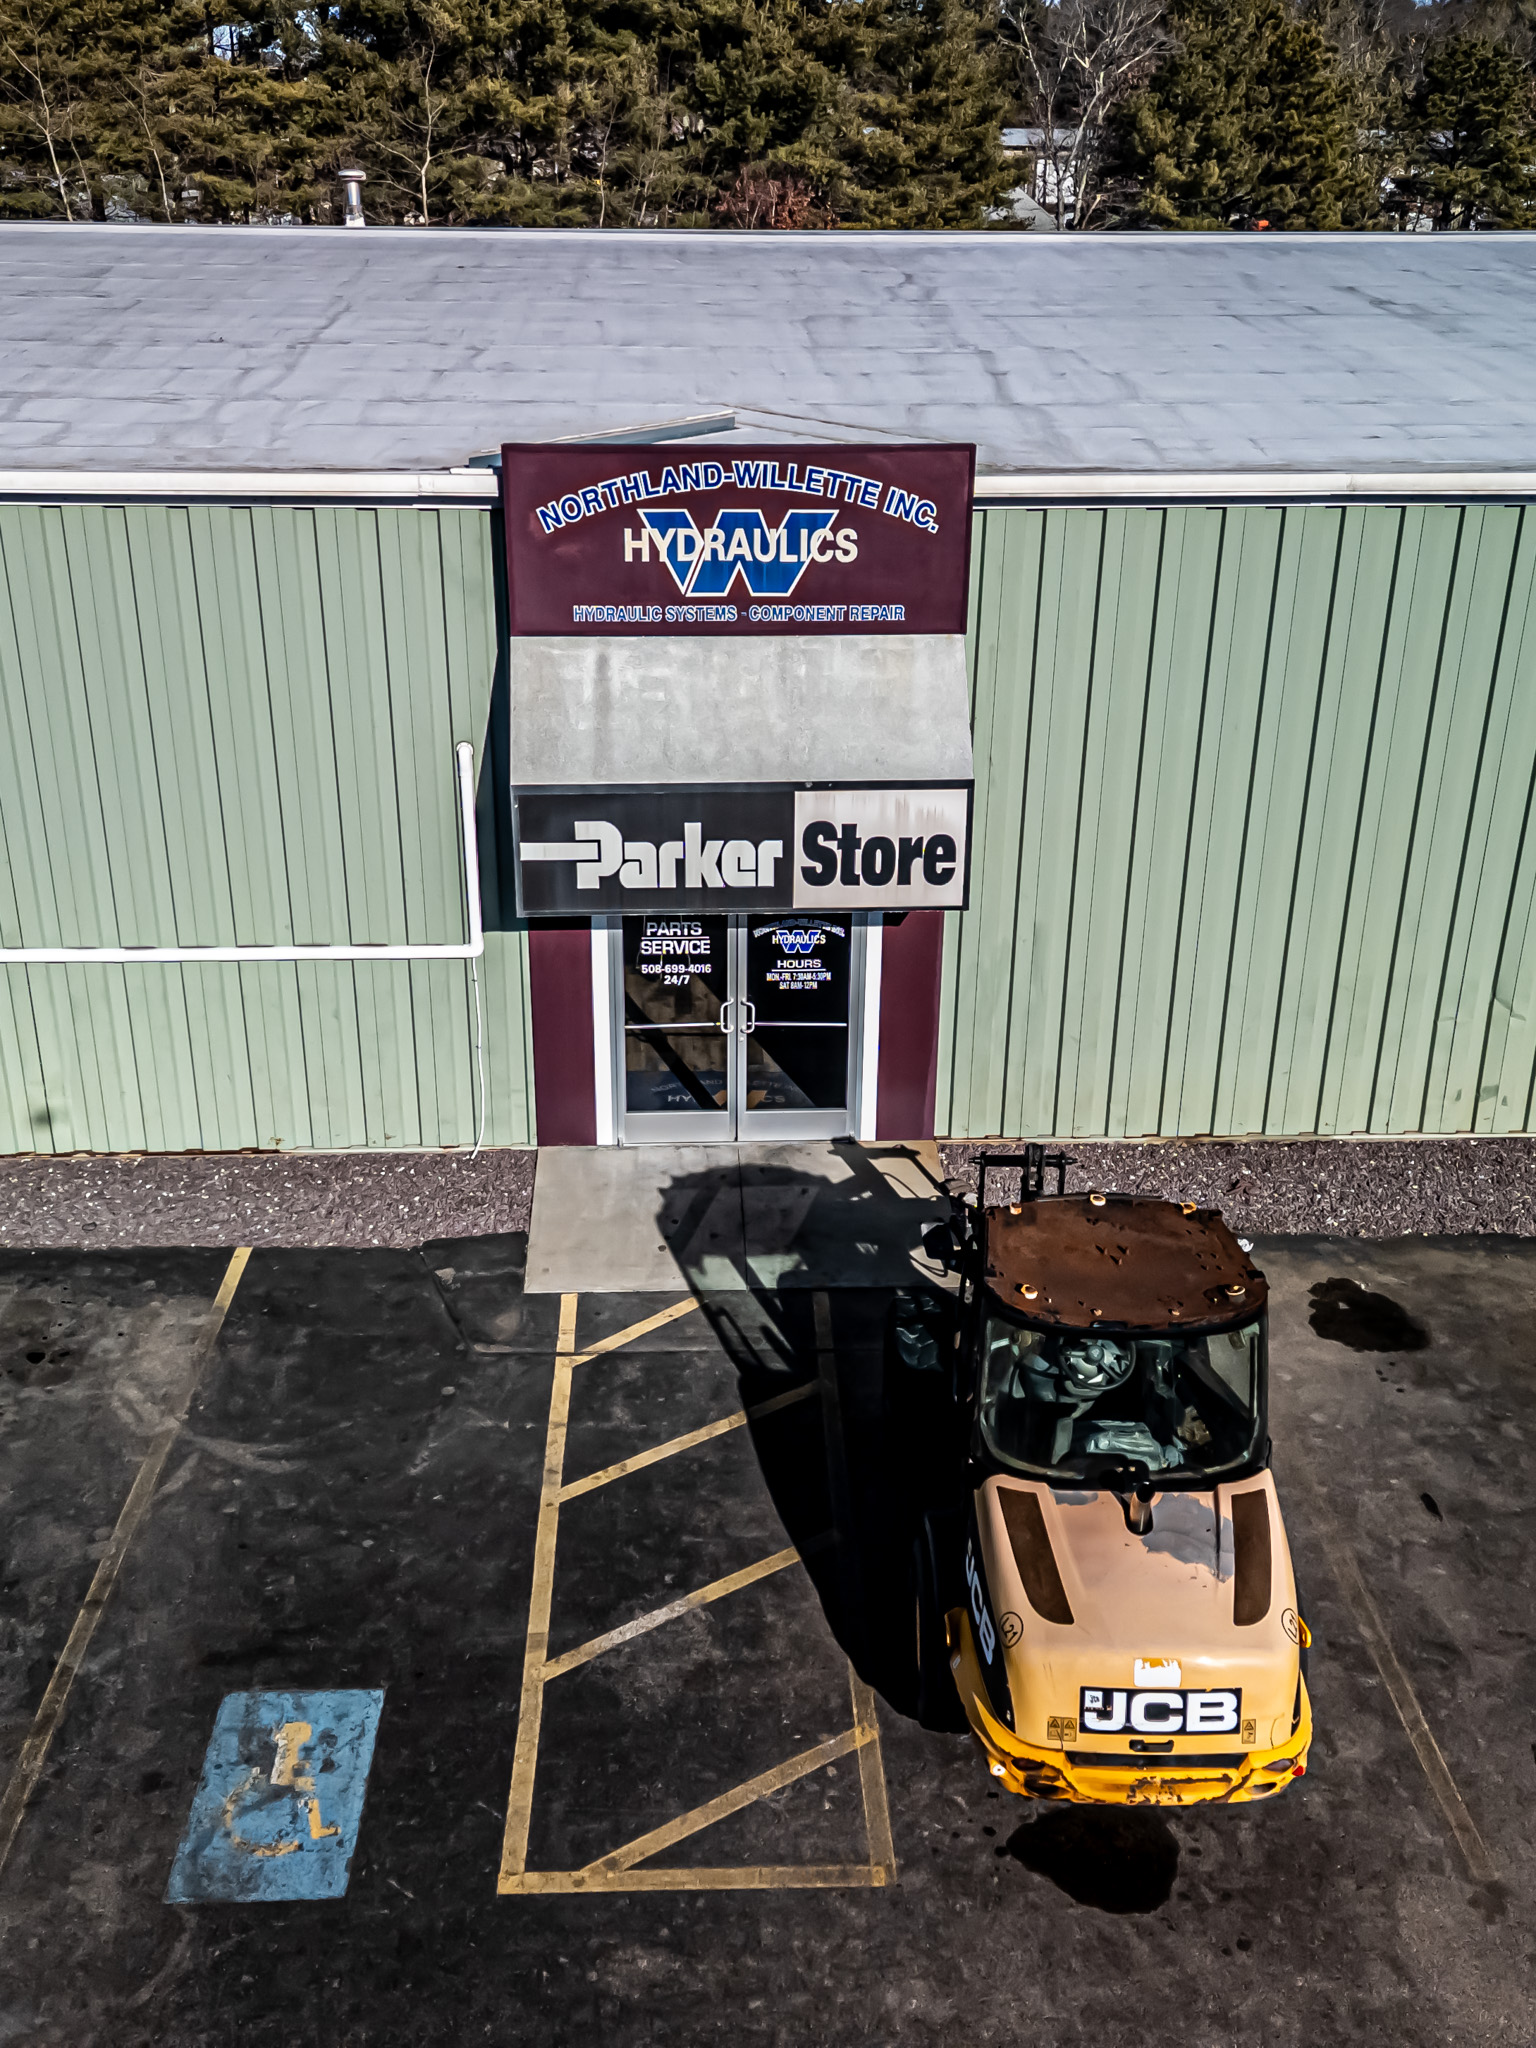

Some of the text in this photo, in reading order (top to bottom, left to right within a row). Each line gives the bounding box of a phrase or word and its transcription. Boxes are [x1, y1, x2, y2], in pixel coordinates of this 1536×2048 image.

[536, 460, 941, 534] NORTHLAND-WILLETTE INC.
[624, 528, 858, 563] HYDRAULICS
[573, 605, 662, 622] HYDRAULIC
[664, 605, 737, 622] SYSTEMS
[749, 605, 846, 622] COMPONENT
[848, 605, 905, 621] REPAIR
[574, 821, 957, 889] Parker Store
[646, 922, 703, 936] PARTS
[772, 934, 826, 944] HYDRAULICS
[641, 940, 711, 954] SERVICE
[641, 964, 712, 974] 508-699-4016
[777, 959, 821, 968] HOURS
[664, 975, 690, 986] 24/7
[966, 1538, 996, 1665] JCB
[1084, 1690, 1238, 1732] JCB
